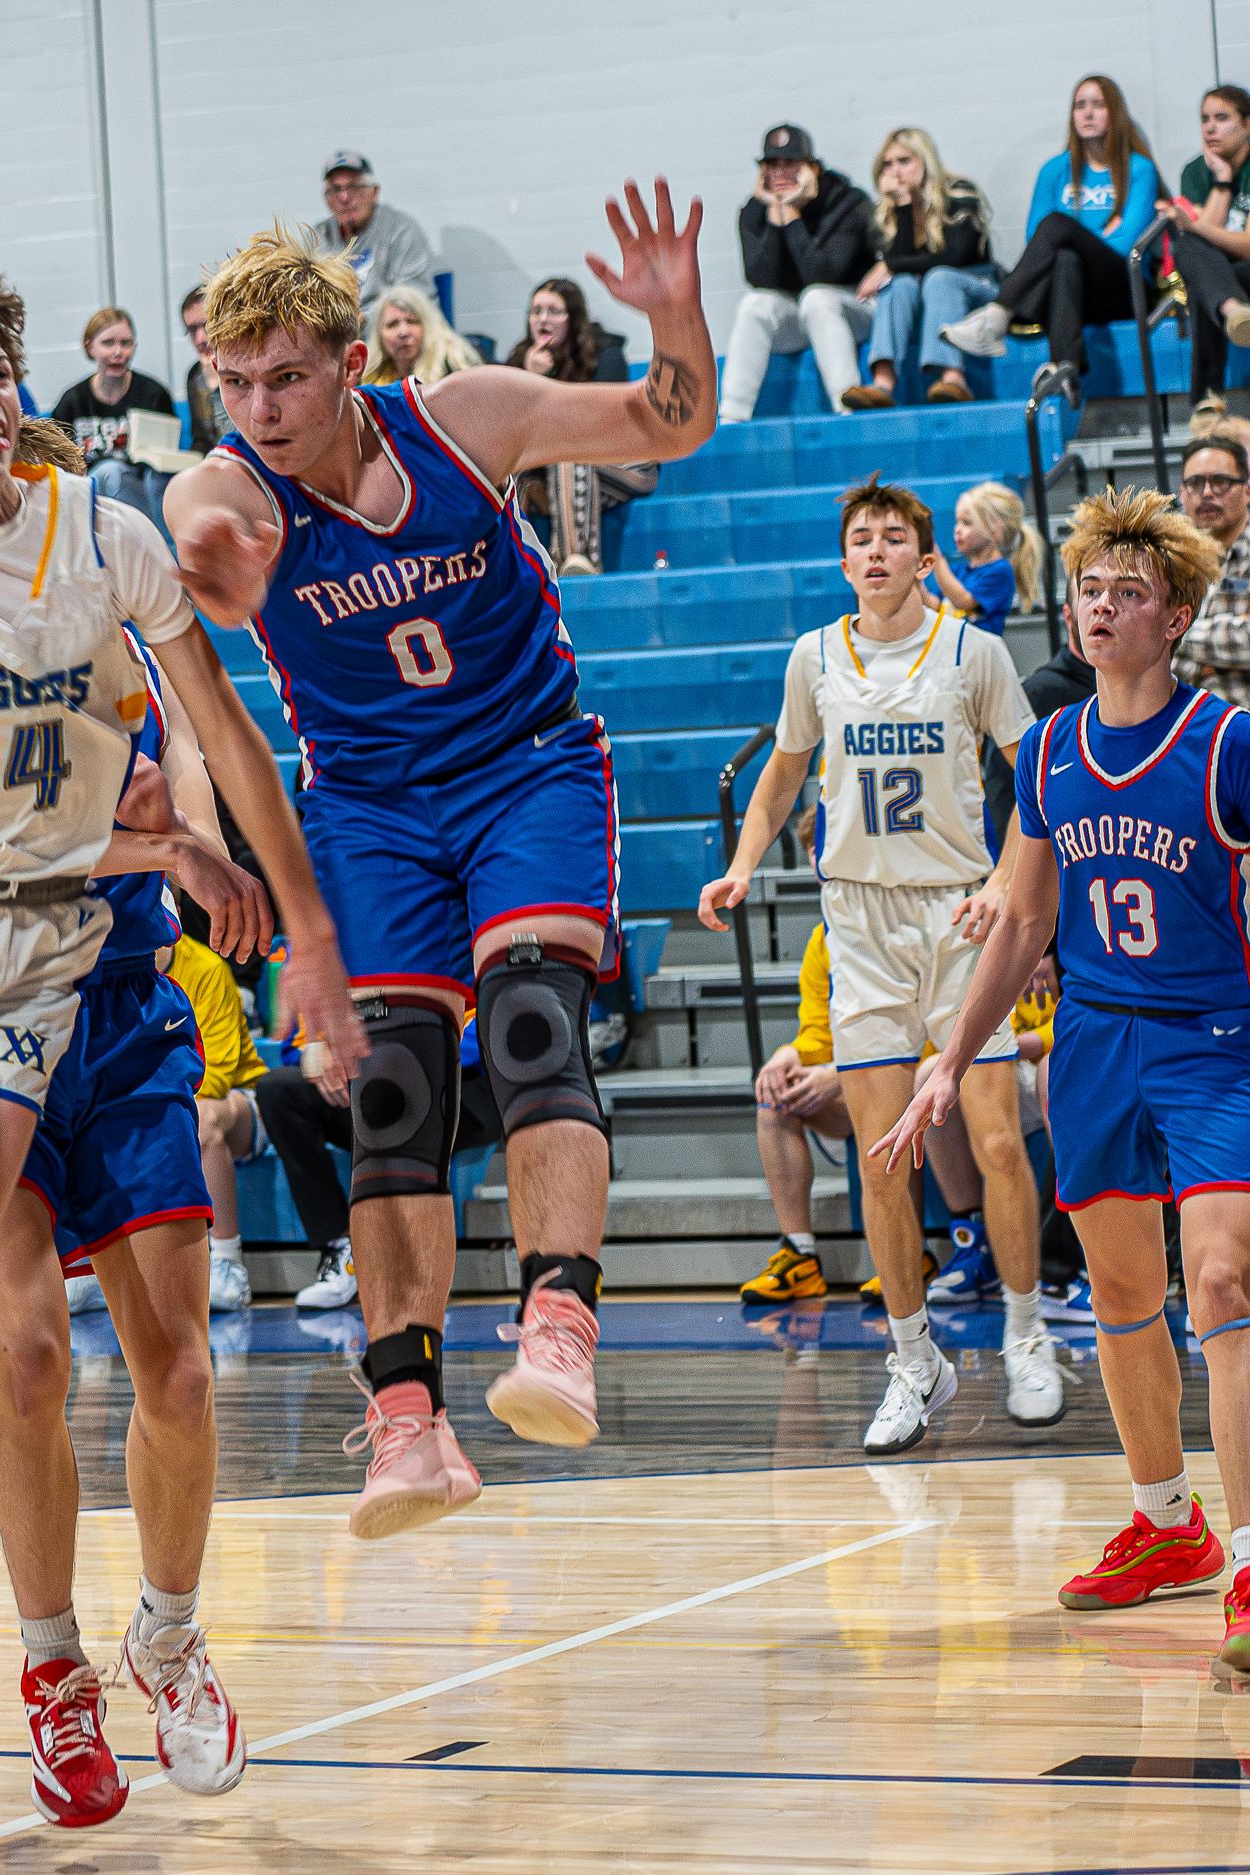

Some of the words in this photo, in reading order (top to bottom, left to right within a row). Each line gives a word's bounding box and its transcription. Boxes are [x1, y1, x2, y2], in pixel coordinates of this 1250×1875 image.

[294, 540, 487, 627] TROOPERS
[387, 616, 455, 688] 0
[3, 718, 72, 811] 4
[844, 721, 945, 756] AGGIES
[857, 767, 925, 836] 12
[1054, 814, 1198, 874] TROOPERS
[1088, 877, 1160, 958] 13
